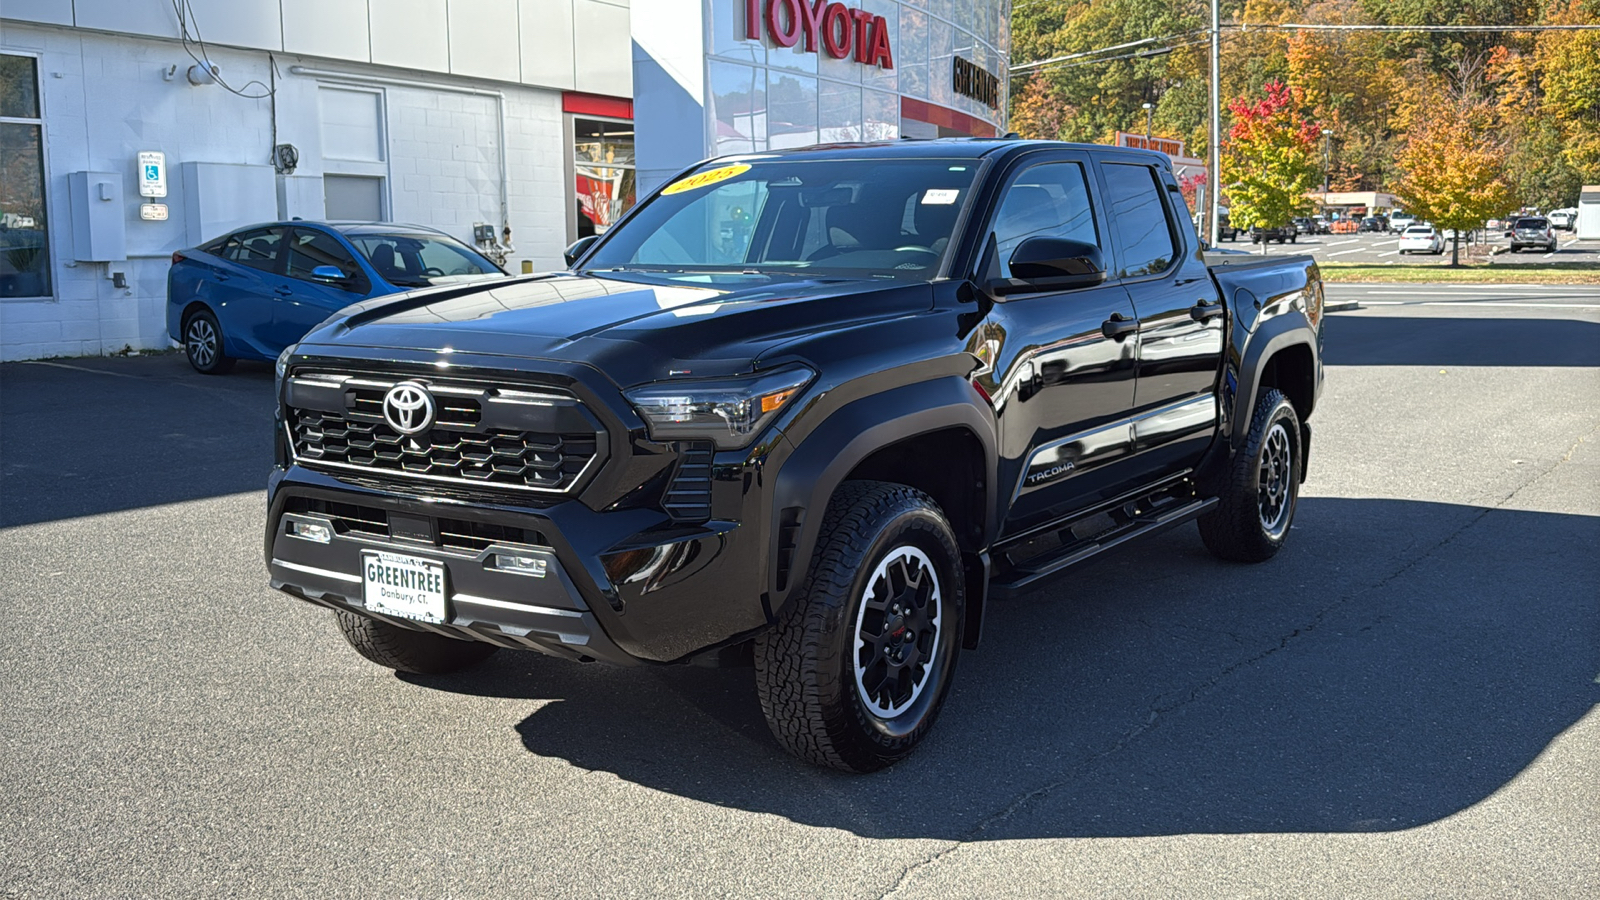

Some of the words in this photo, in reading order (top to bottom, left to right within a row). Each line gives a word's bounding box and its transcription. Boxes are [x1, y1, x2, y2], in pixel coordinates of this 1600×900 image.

[745, 0, 893, 69] TOYOTA
[1126, 136, 1140, 148] THE
[1161, 141, 1180, 156] DEPOT
[675, 167, 737, 191] 2025
[1028, 461, 1075, 483] TACOMA
[367, 563, 441, 594] GREENTREE
[381, 587, 415, 605] Danbury,
[417, 593, 429, 605] CT.
